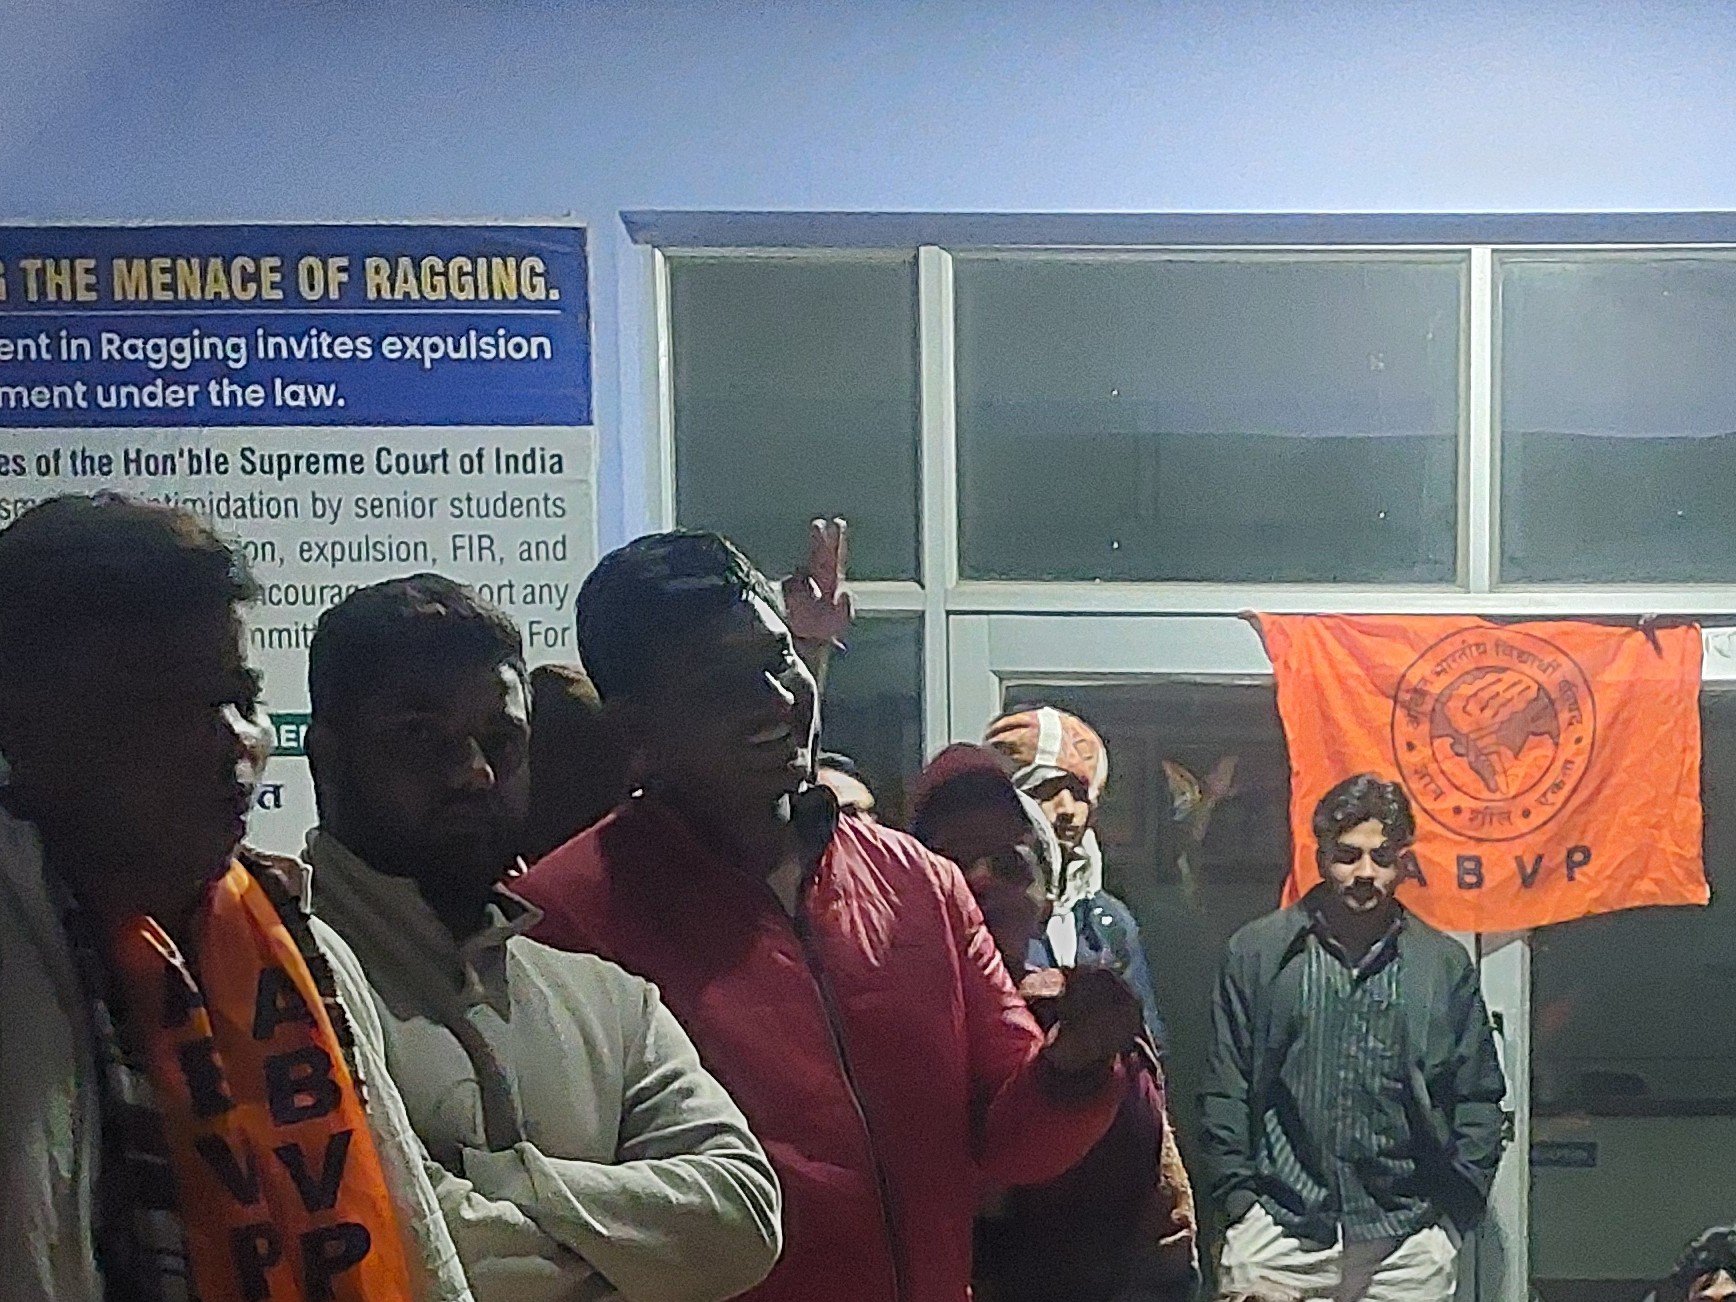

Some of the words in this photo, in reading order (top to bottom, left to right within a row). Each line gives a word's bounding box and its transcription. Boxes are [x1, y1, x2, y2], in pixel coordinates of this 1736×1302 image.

[19, 258, 97, 301] THE
[112, 257, 283, 301] MENACE
[298, 256, 350, 300] OF
[365, 255, 561, 301] RAGGING.
[60, 332, 91, 361] in
[101, 329, 248, 369] Ragging
[256, 329, 373, 360] invites
[381, 328, 552, 369] expulsion
[97, 378, 198, 408] under
[207, 378, 265, 407] the
[273, 376, 346, 407] law.
[35, 448, 63, 476] of
[69, 448, 113, 476] the
[122, 445, 229, 476] Hon'ble
[239, 447, 365, 480] Supreme
[375, 446, 449, 474] Court
[458, 445, 484, 474] of
[494, 445, 564, 473] India
[310, 490, 341, 524] by
[353, 490, 437, 518] senior
[449, 489, 566, 518] students
[299, 534, 437, 570] expulsion,
[452, 535, 504, 566] FIR,
[518, 535, 567, 562] and
[522, 581, 568, 614] any
[528, 620, 570, 648] For
